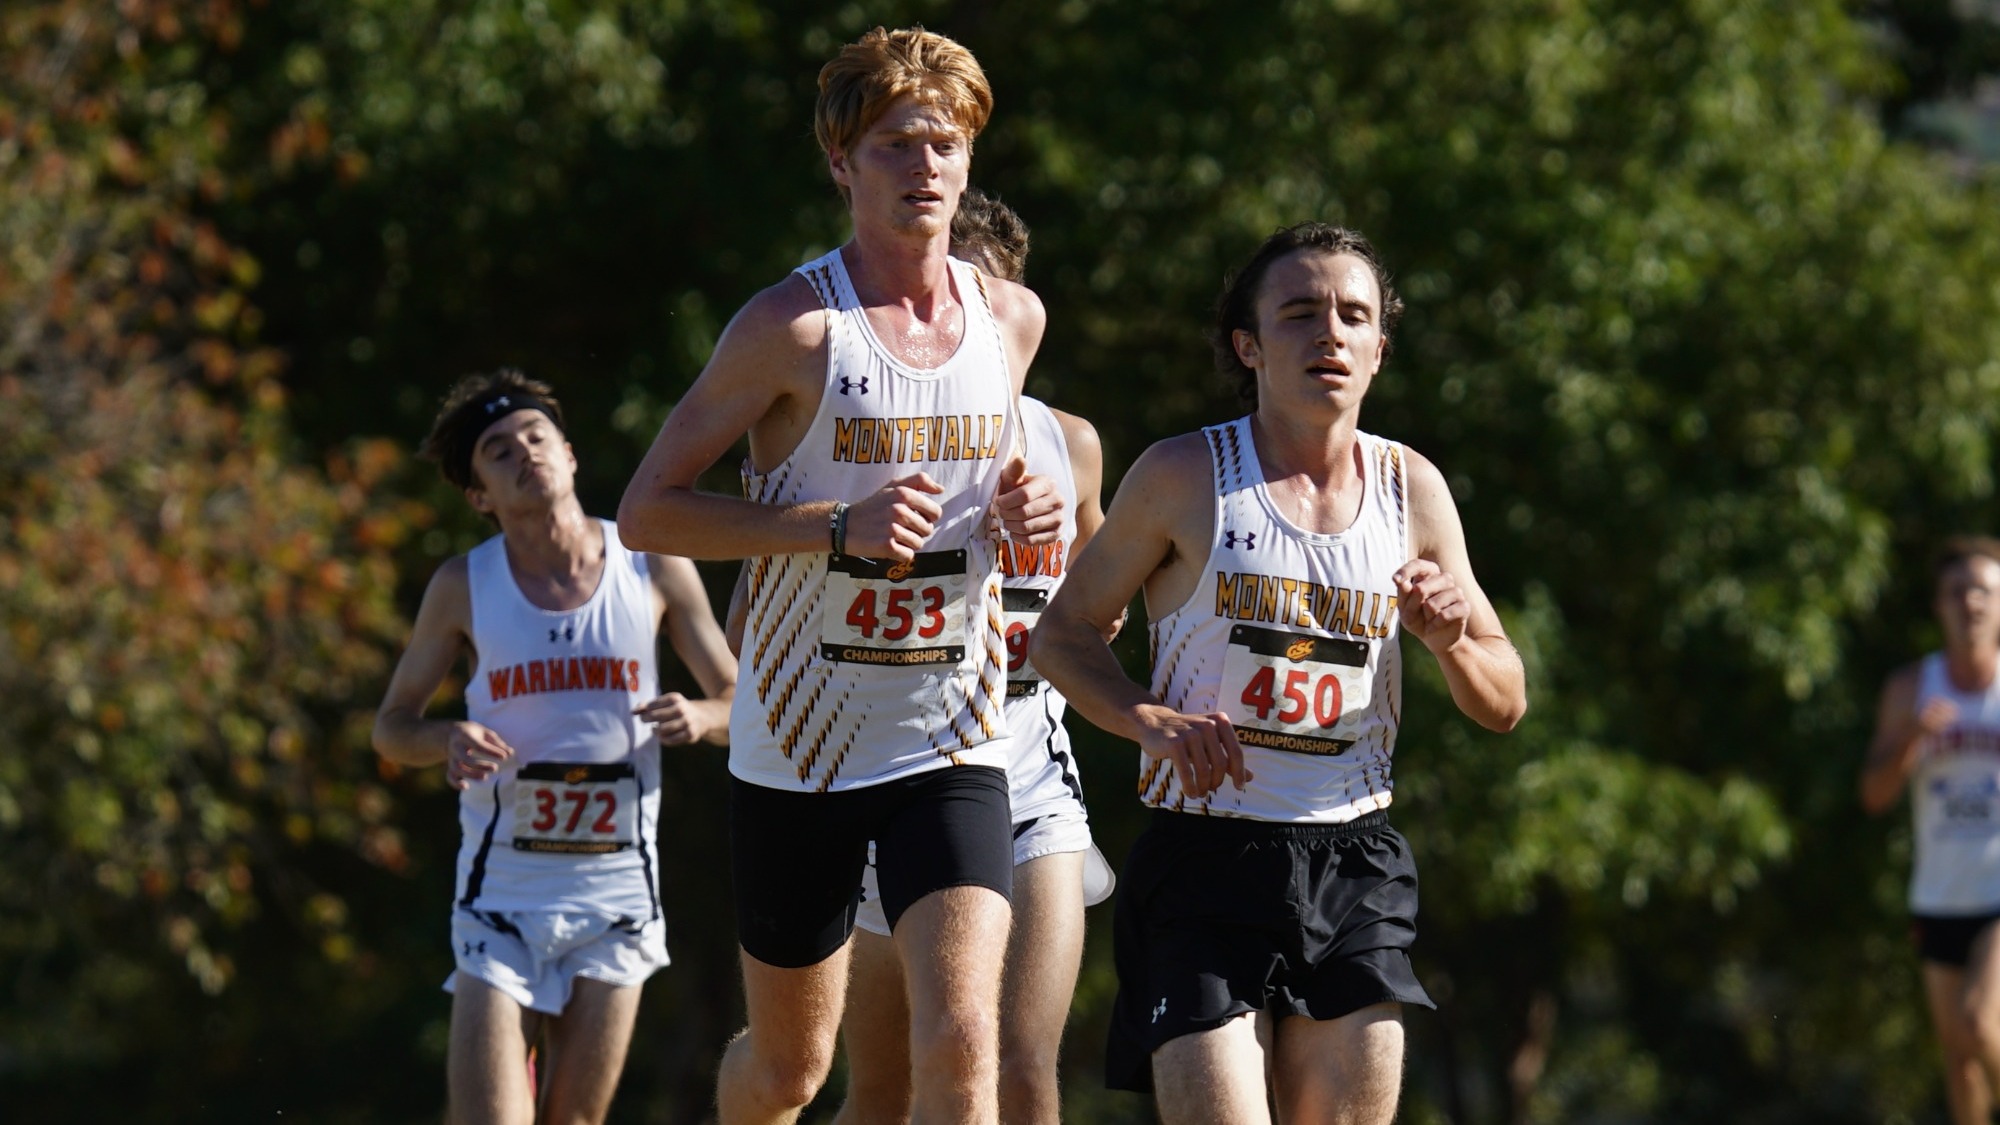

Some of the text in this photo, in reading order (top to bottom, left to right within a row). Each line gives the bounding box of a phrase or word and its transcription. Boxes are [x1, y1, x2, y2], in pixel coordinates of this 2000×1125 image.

[846, 586, 946, 641] 453
[843, 649, 948, 663] CHAMPIONSHIPS
[1286, 638, 1316, 662] GSC
[489, 656, 640, 702] WARHAWKS
[1241, 666, 1343, 729] 450
[1235, 729, 1339, 754] CHAMPIONSHIPS
[531, 787, 617, 834] 372
